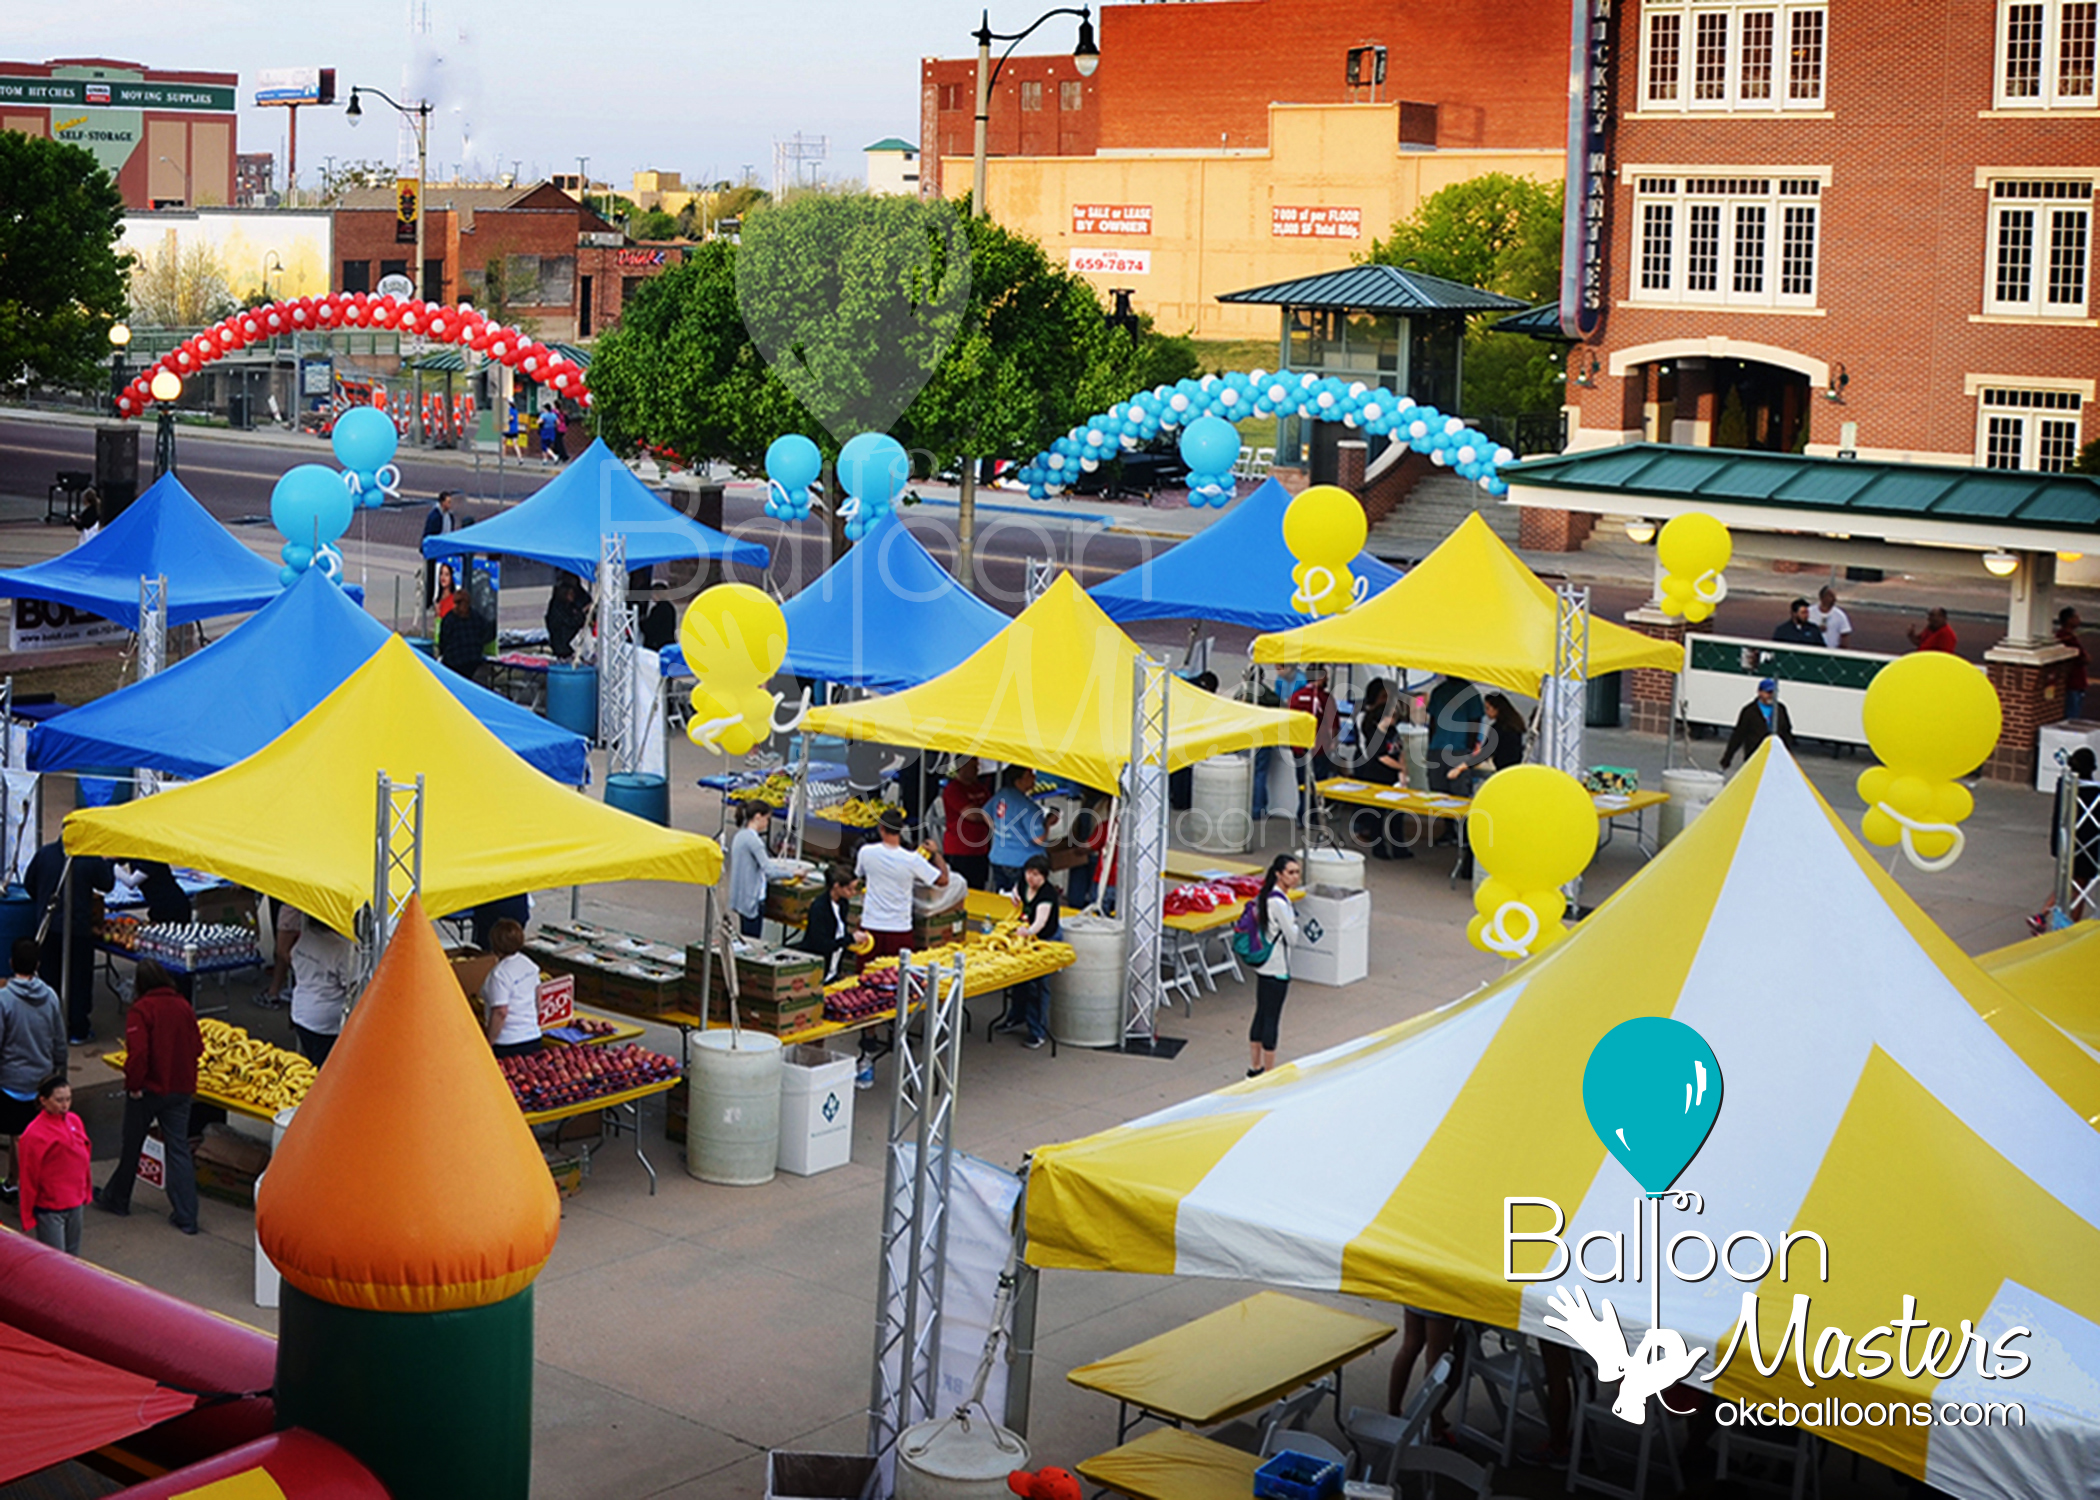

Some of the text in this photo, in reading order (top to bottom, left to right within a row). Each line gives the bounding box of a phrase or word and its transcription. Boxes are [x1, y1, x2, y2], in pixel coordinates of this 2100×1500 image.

[29, 87, 76, 98] HITCHES
[121, 90, 162, 101] MOVING
[167, 92, 212, 104] SUPPLIES
[58, 130, 133, 143] SELF-STORAGE
[1088, 206, 1111, 218] SALE
[1124, 207, 1152, 219] LEASE
[1328, 210, 1360, 222] FLOOR
[1076, 220, 1148, 233] BY OWNER
